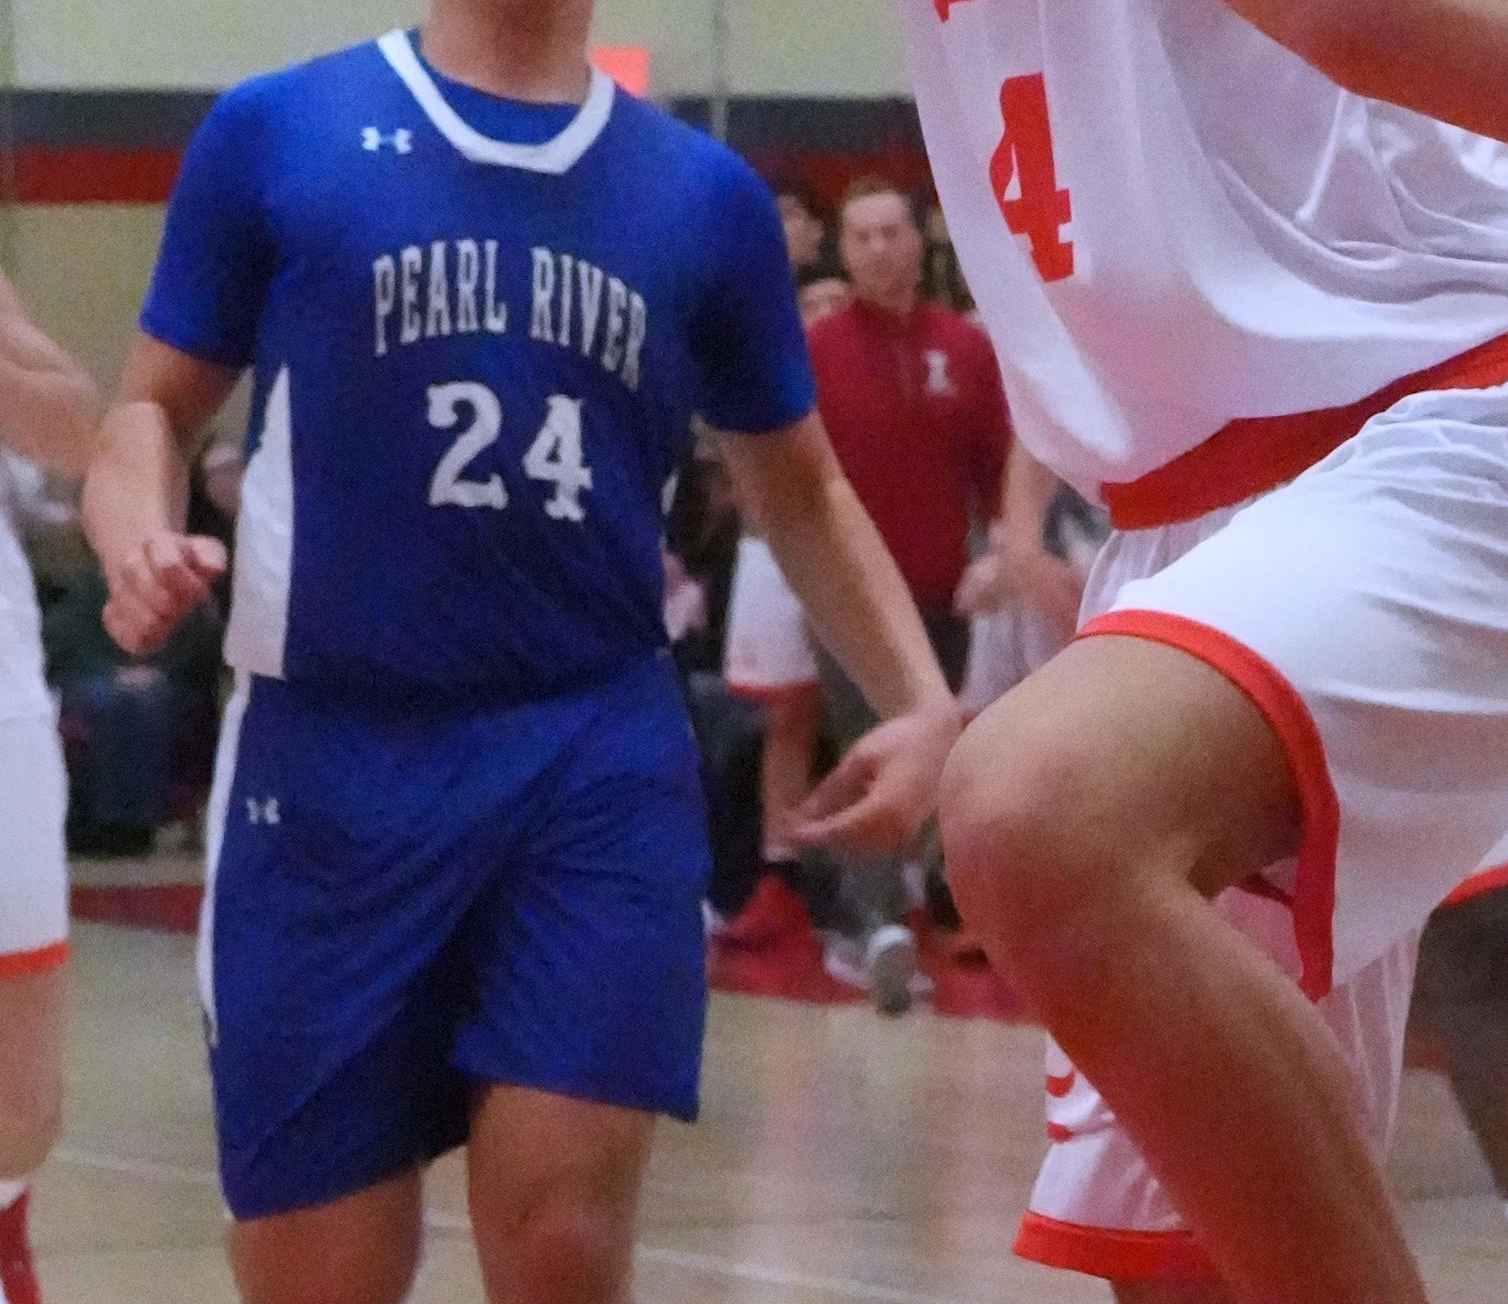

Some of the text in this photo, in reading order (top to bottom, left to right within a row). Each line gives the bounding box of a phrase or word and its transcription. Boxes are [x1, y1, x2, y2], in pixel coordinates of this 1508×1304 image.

[989, 72, 1075, 282] 4
[372, 238, 648, 391] PEARL RIVER
[426, 381, 594, 523] 24
